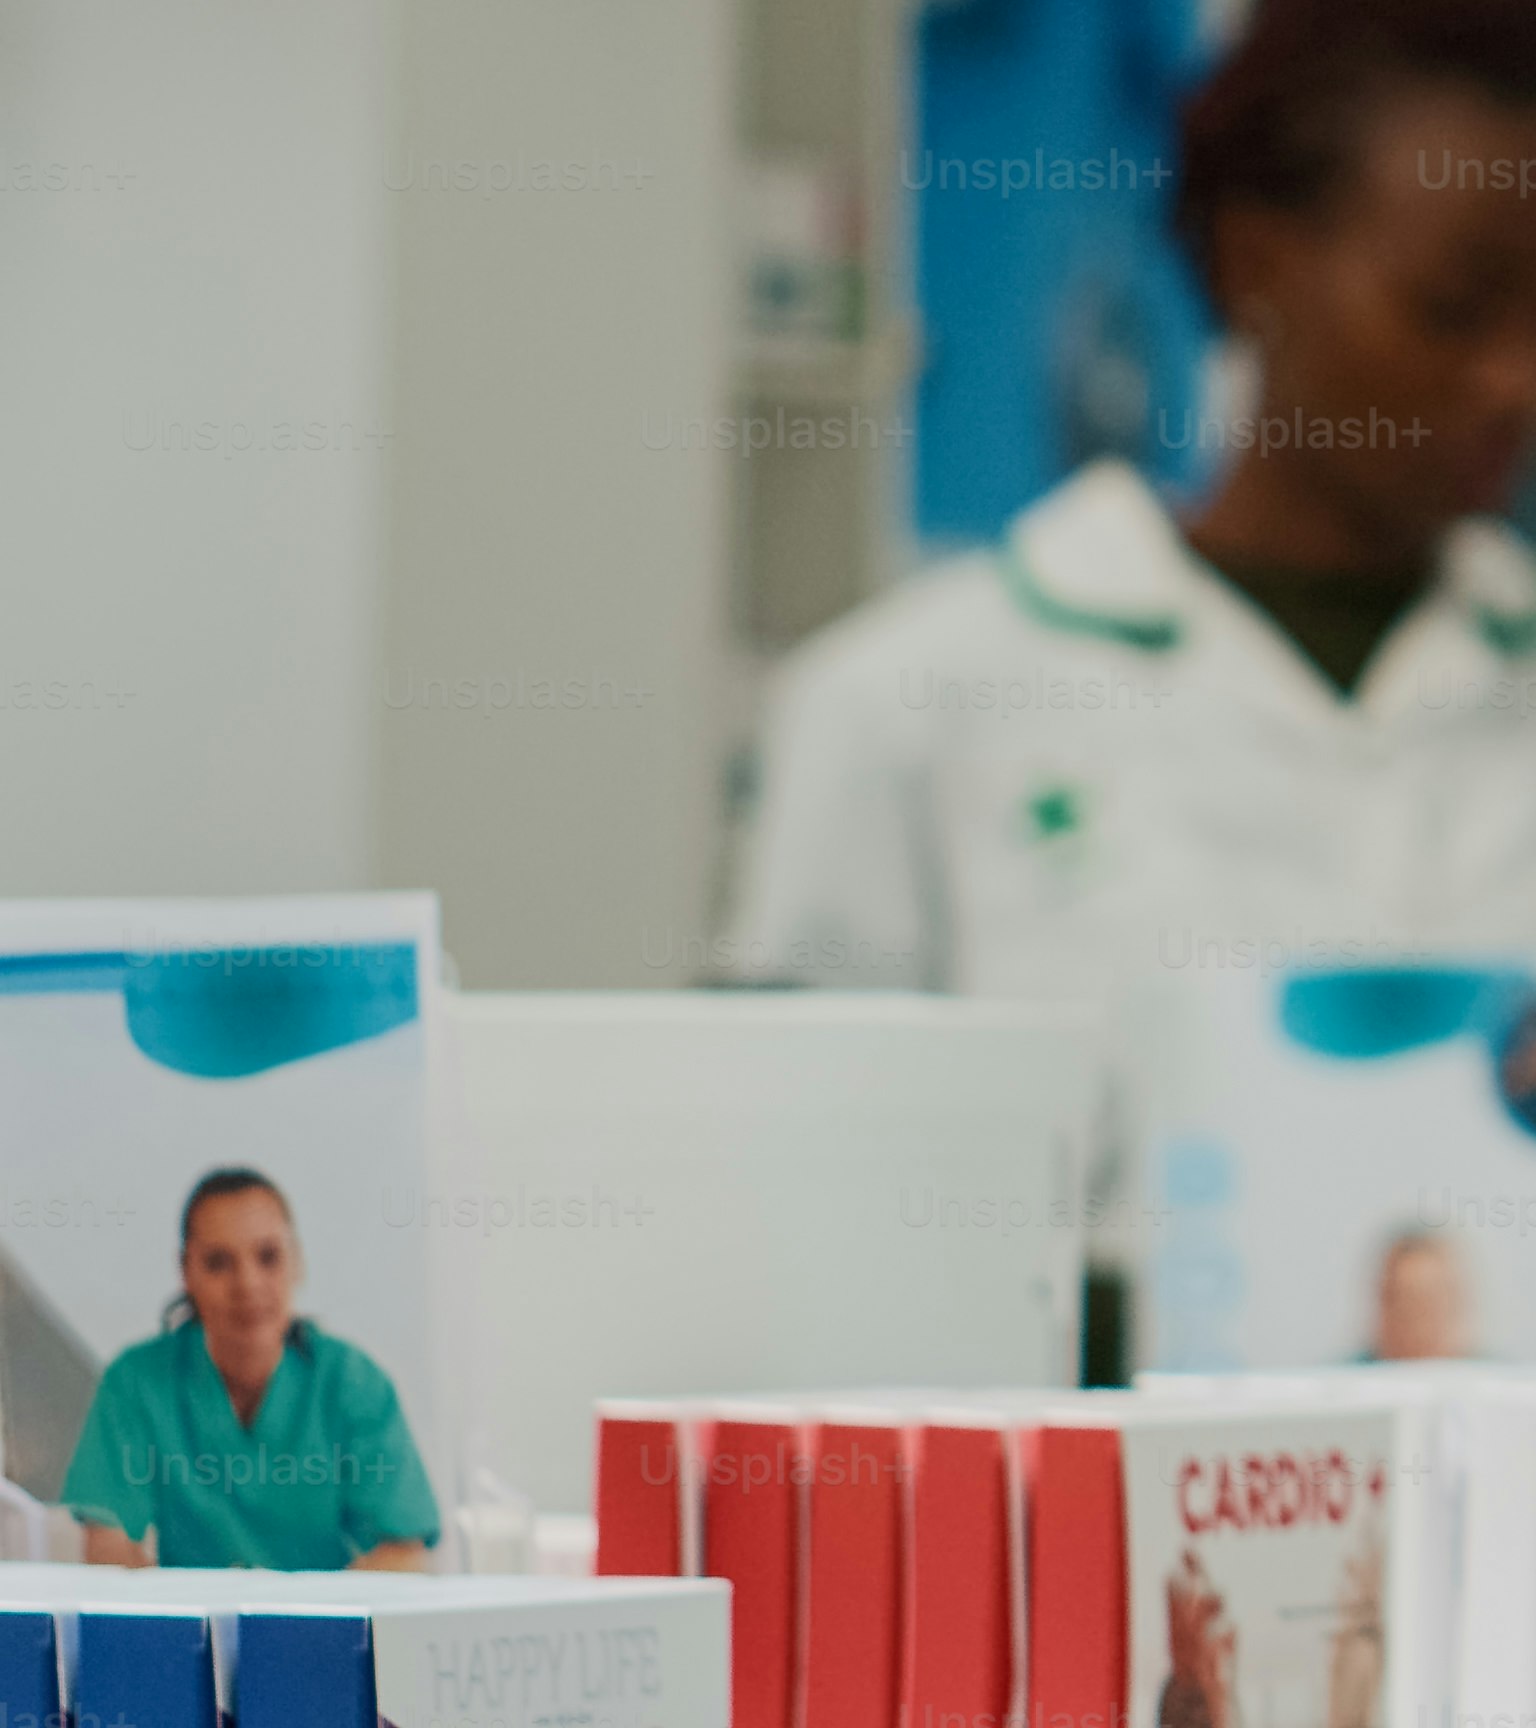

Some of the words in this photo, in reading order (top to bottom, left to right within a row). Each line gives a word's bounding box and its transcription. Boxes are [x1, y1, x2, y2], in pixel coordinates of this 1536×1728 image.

[1176, 1448, 1353, 1532] CARDIO
[426, 1632, 568, 1714] HAPPY
[571, 1625, 662, 1700] LIFE
